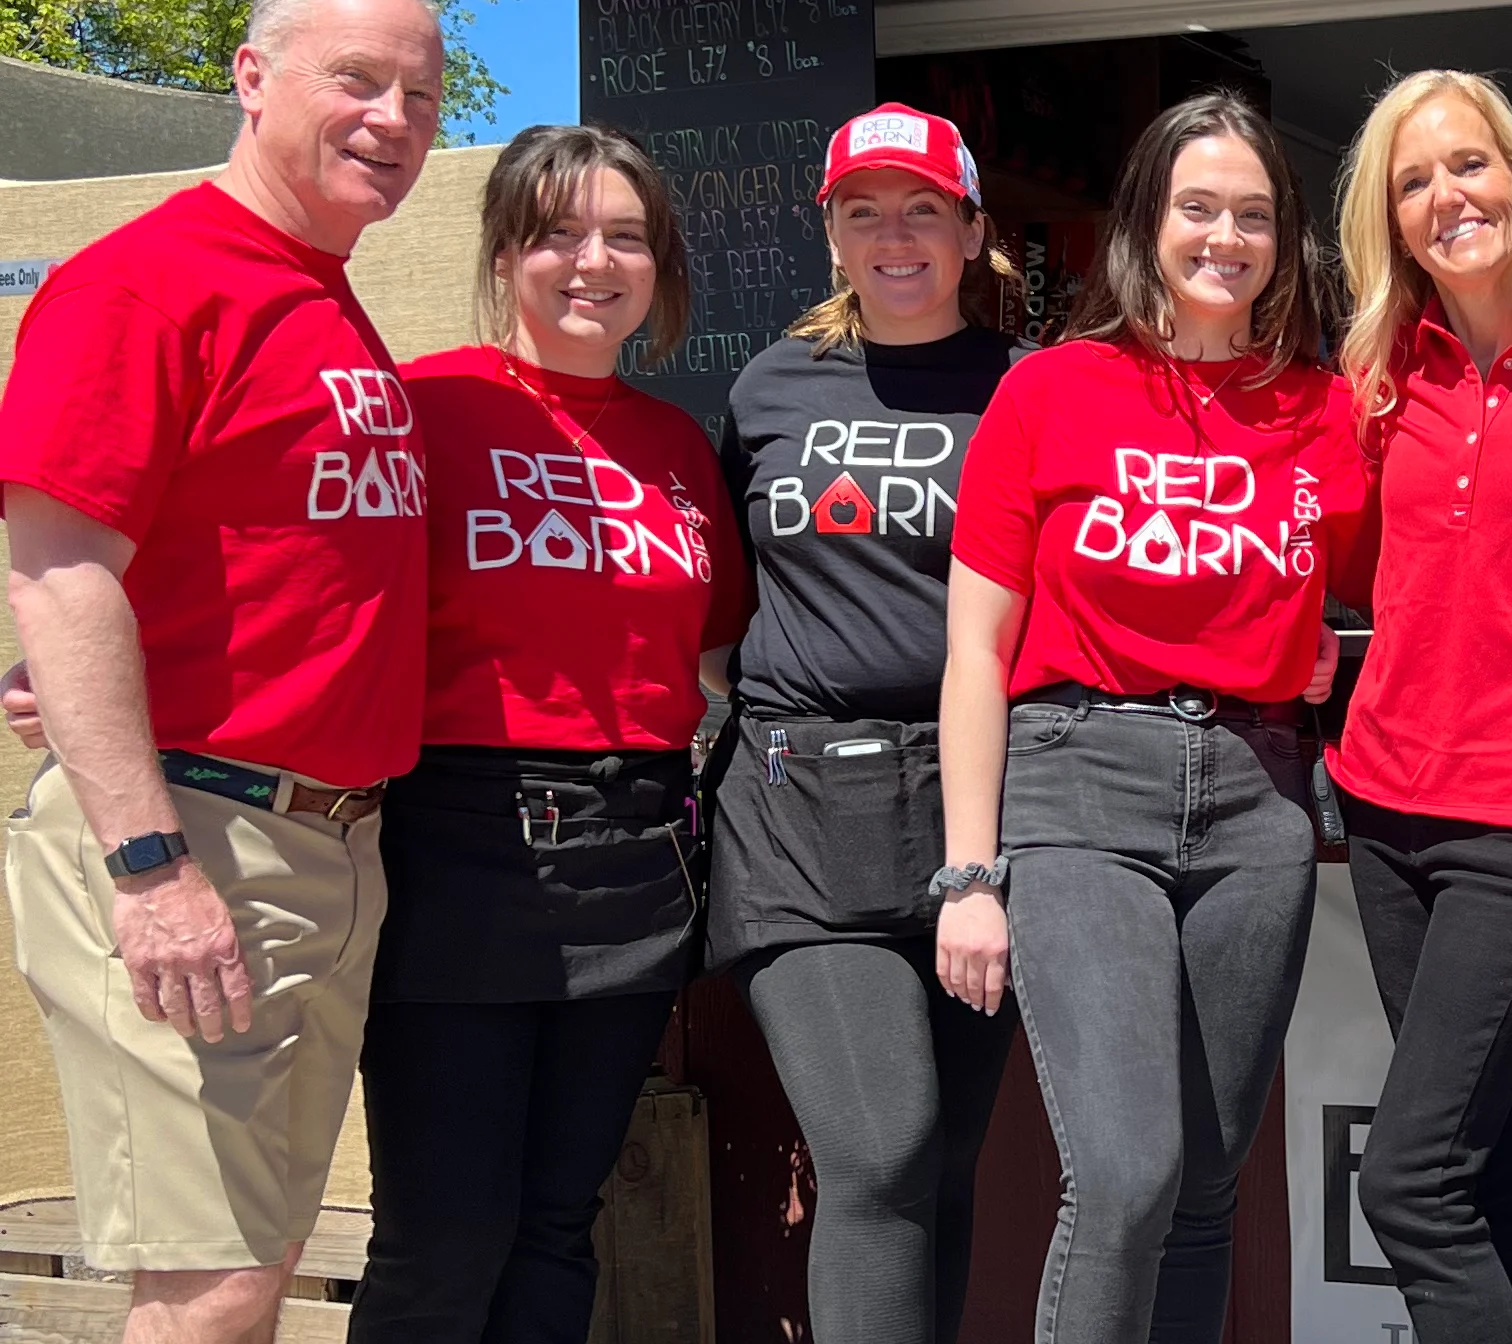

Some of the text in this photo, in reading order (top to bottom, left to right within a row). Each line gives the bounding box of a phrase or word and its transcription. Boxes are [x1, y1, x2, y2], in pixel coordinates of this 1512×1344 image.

[599, 11, 663, 54] BLACK
[862, 118, 904, 133] RED
[668, 163, 783, 212] S/GINGER
[681, 209, 729, 252] EAR
[19, 268, 40, 289] Only
[686, 332, 752, 373] GETTER
[319, 368, 413, 436] RED
[800, 419, 954, 467] RED
[490, 448, 644, 509] RED
[1114, 448, 1255, 514] RED
